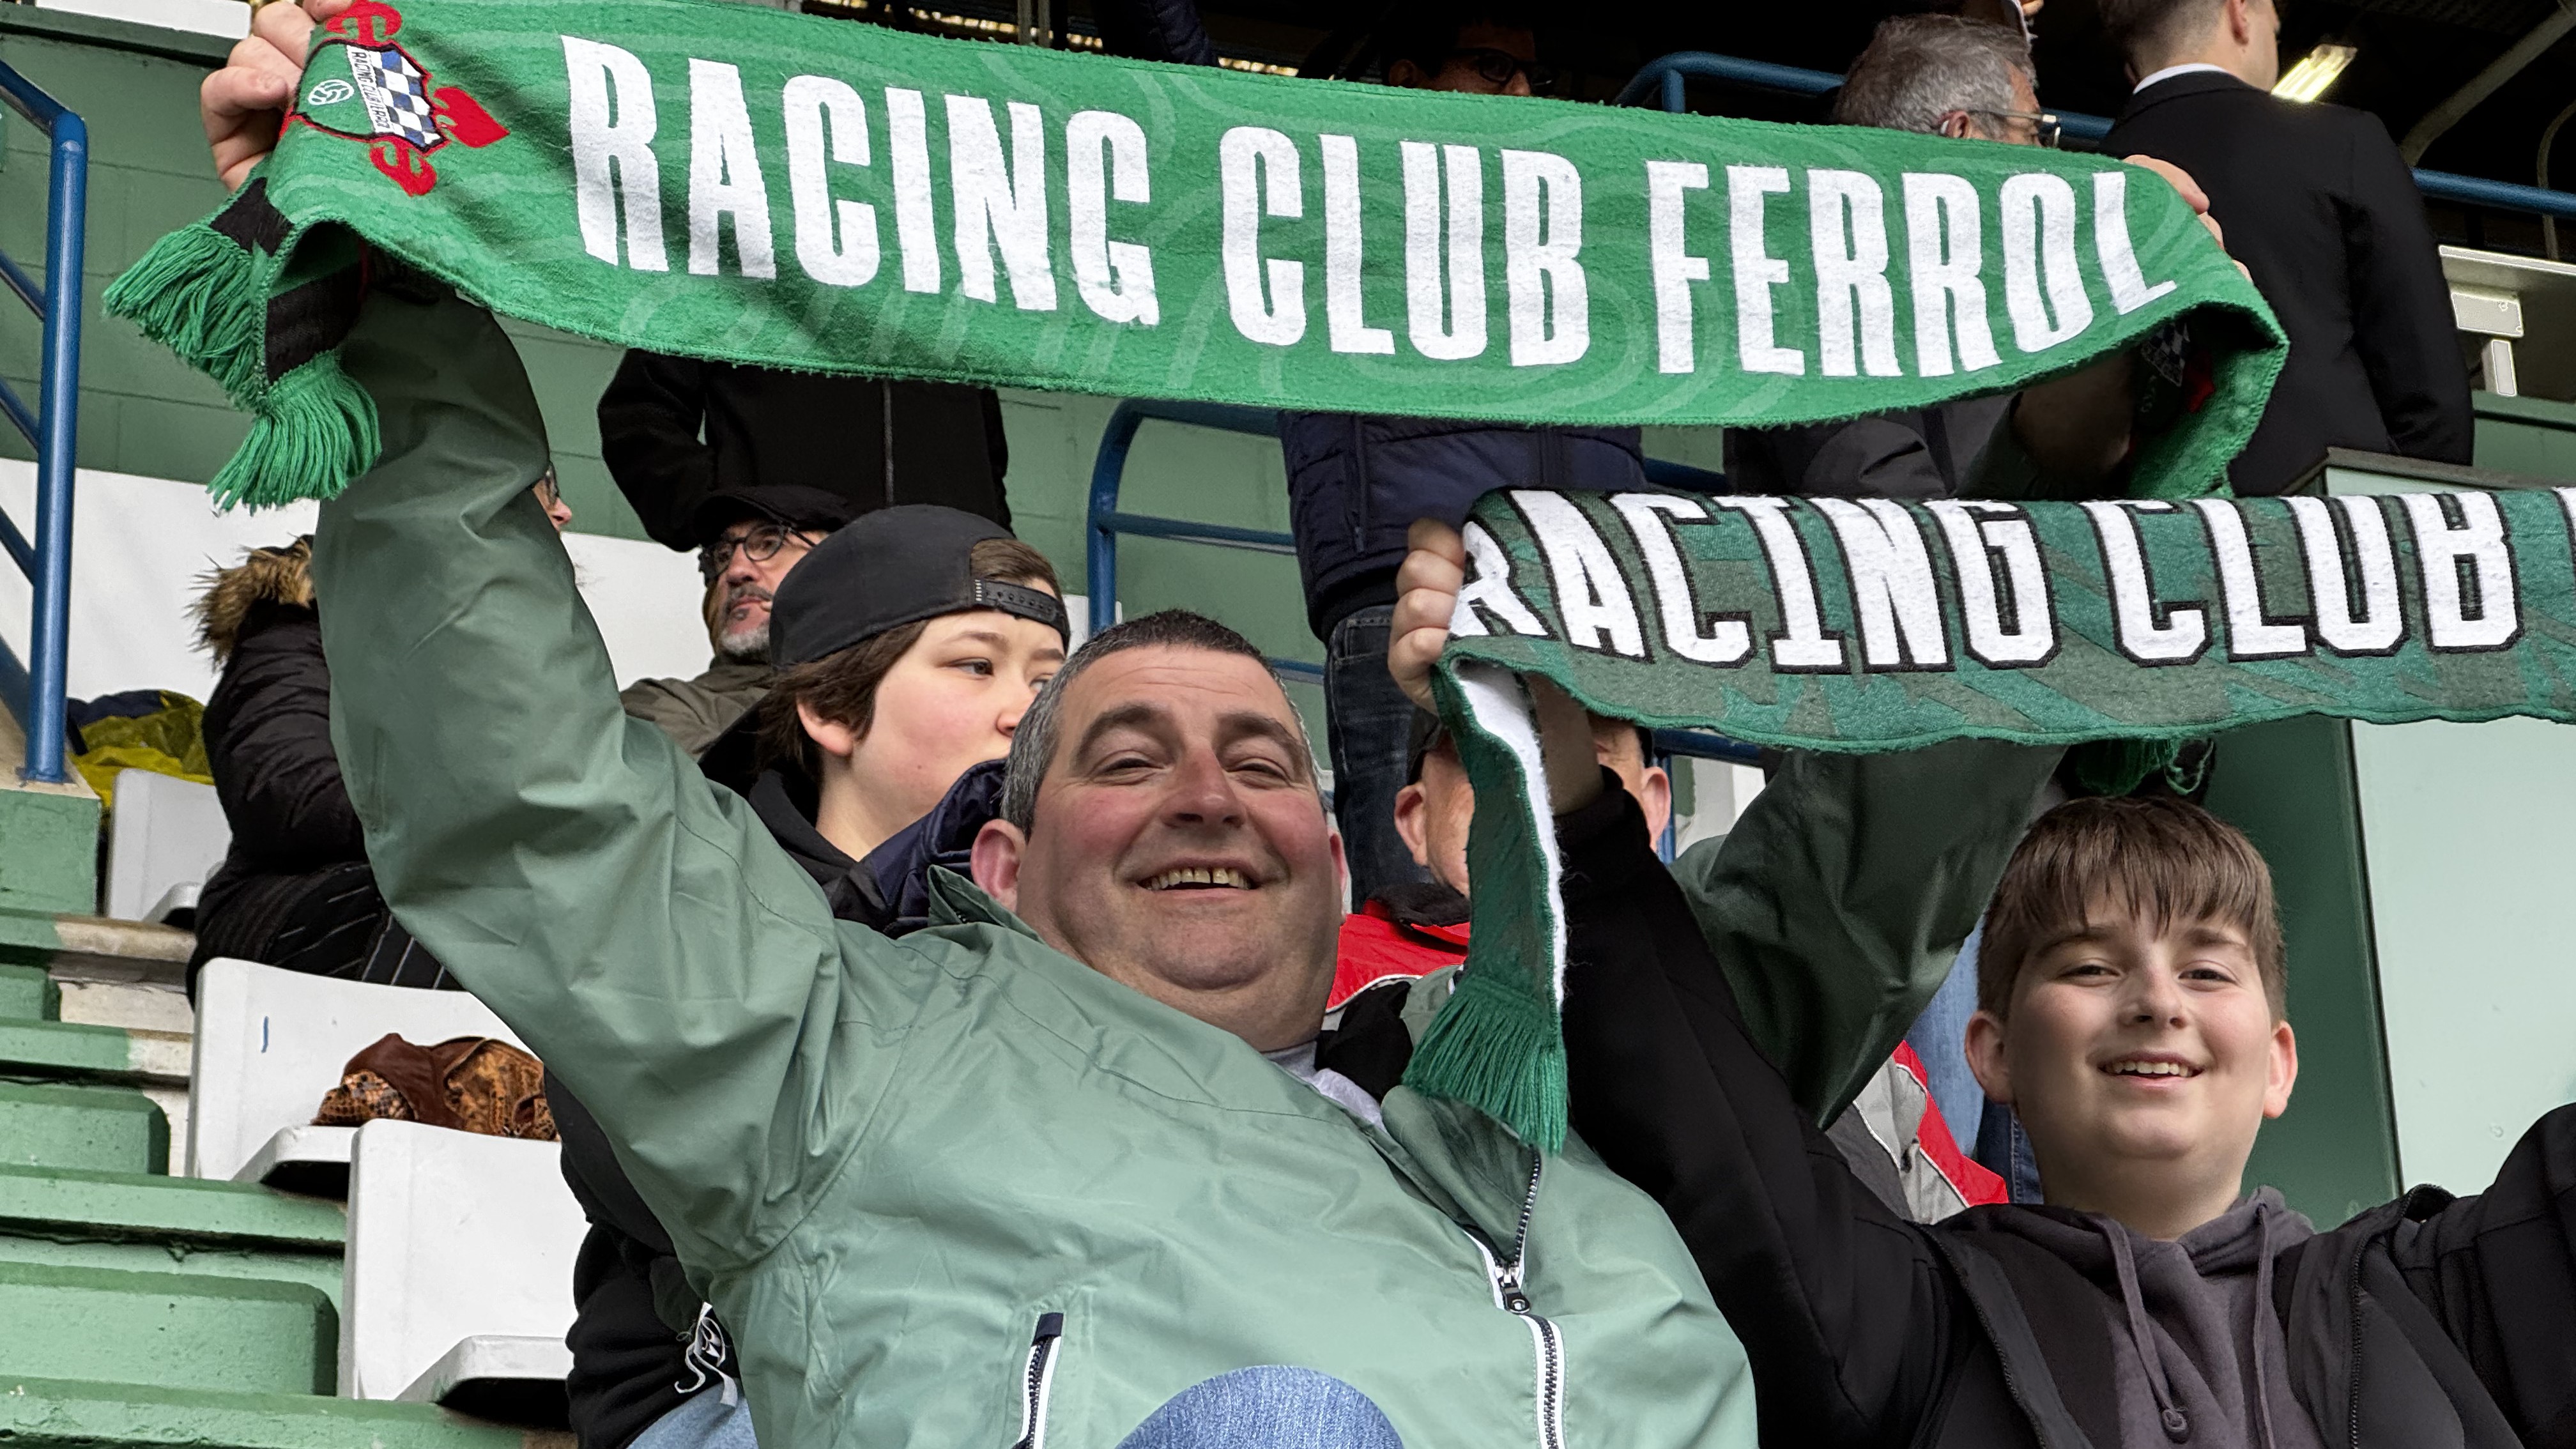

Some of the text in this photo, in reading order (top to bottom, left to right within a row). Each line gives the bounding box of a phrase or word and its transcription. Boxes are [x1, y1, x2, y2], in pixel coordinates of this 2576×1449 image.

[351, 51, 374, 83] RACING
[561, 34, 2177, 378] RACING CLUB FERROL
[1448, 489, 2056, 668] RACING
[2078, 491, 2519, 659] CLUB
